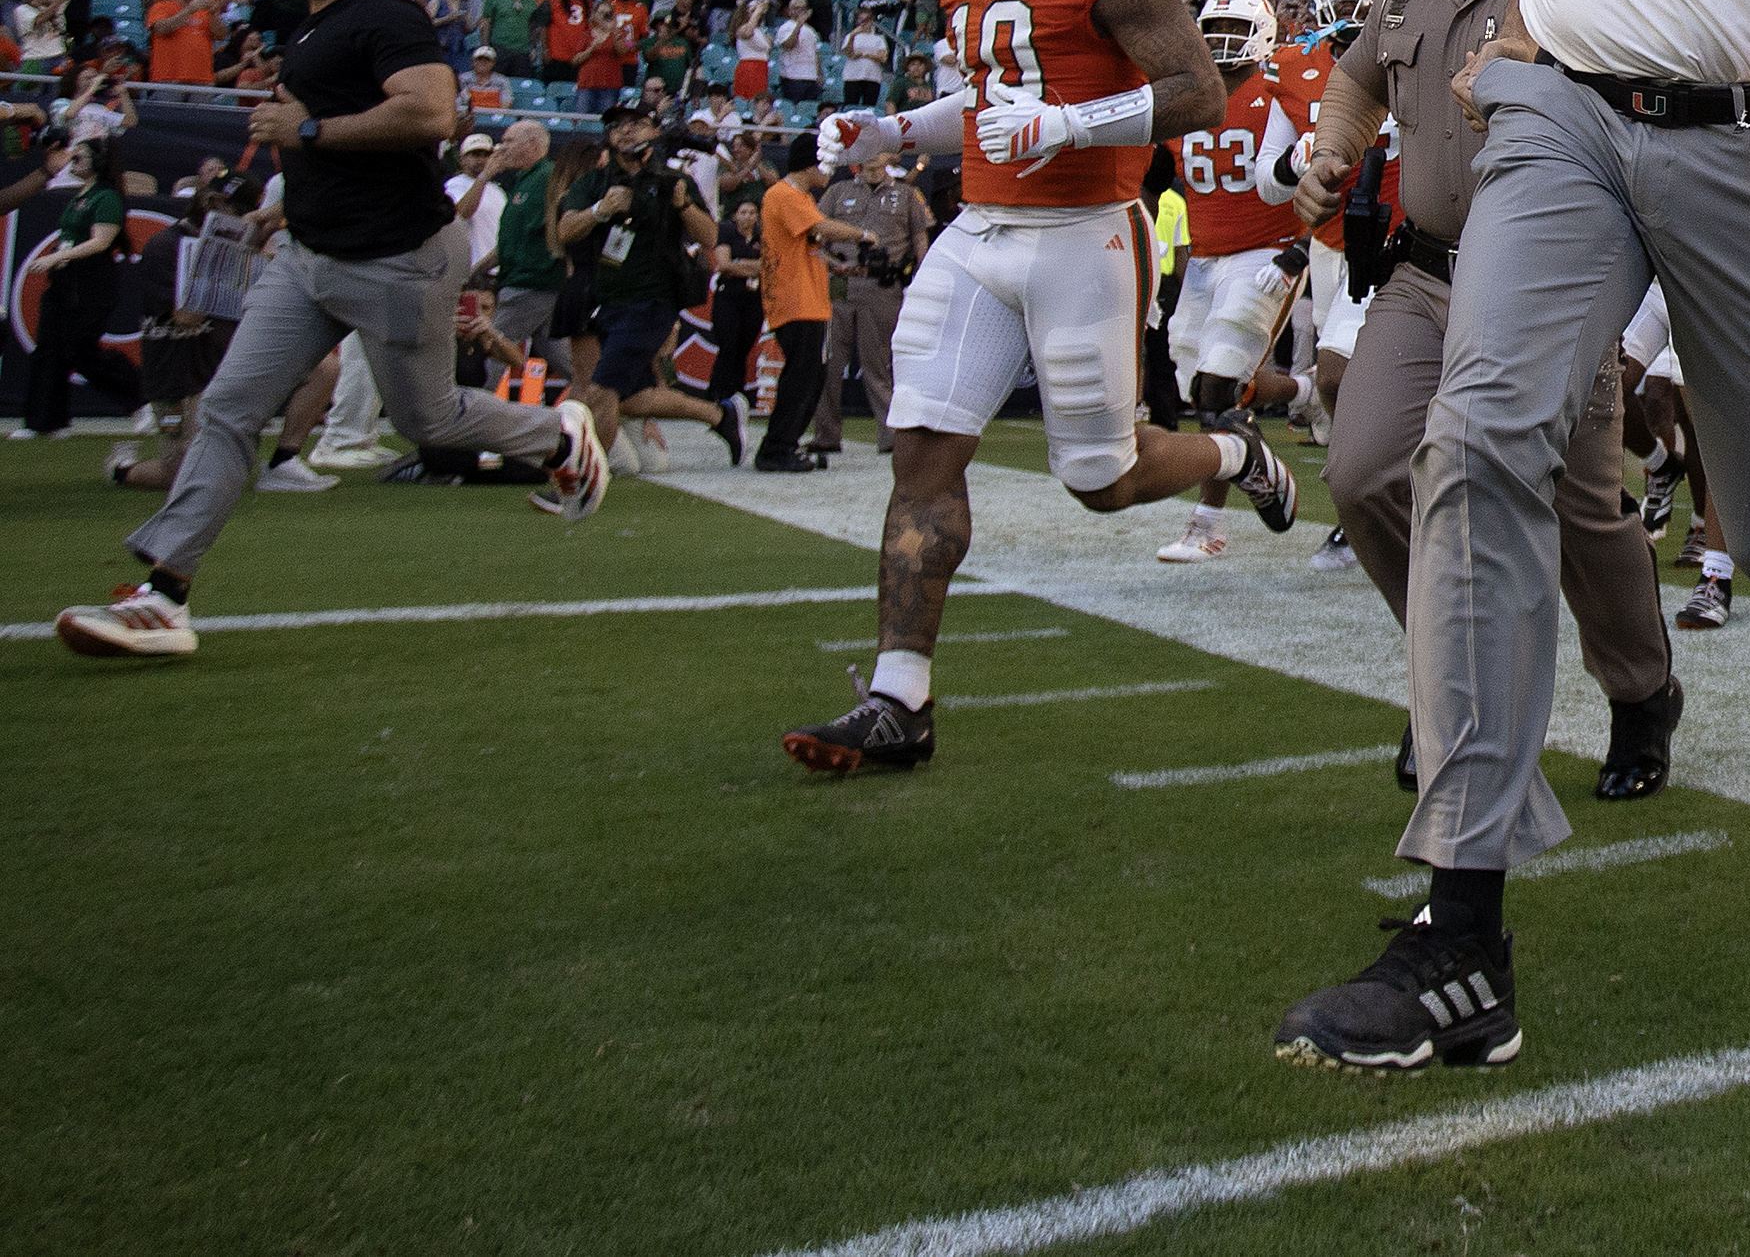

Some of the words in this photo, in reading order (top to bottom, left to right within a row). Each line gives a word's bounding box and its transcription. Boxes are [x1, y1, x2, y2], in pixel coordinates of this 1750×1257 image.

[567, 3, 584, 26] 3
[1631, 91, 1666, 118] U
[1181, 128, 1257, 195] 63
